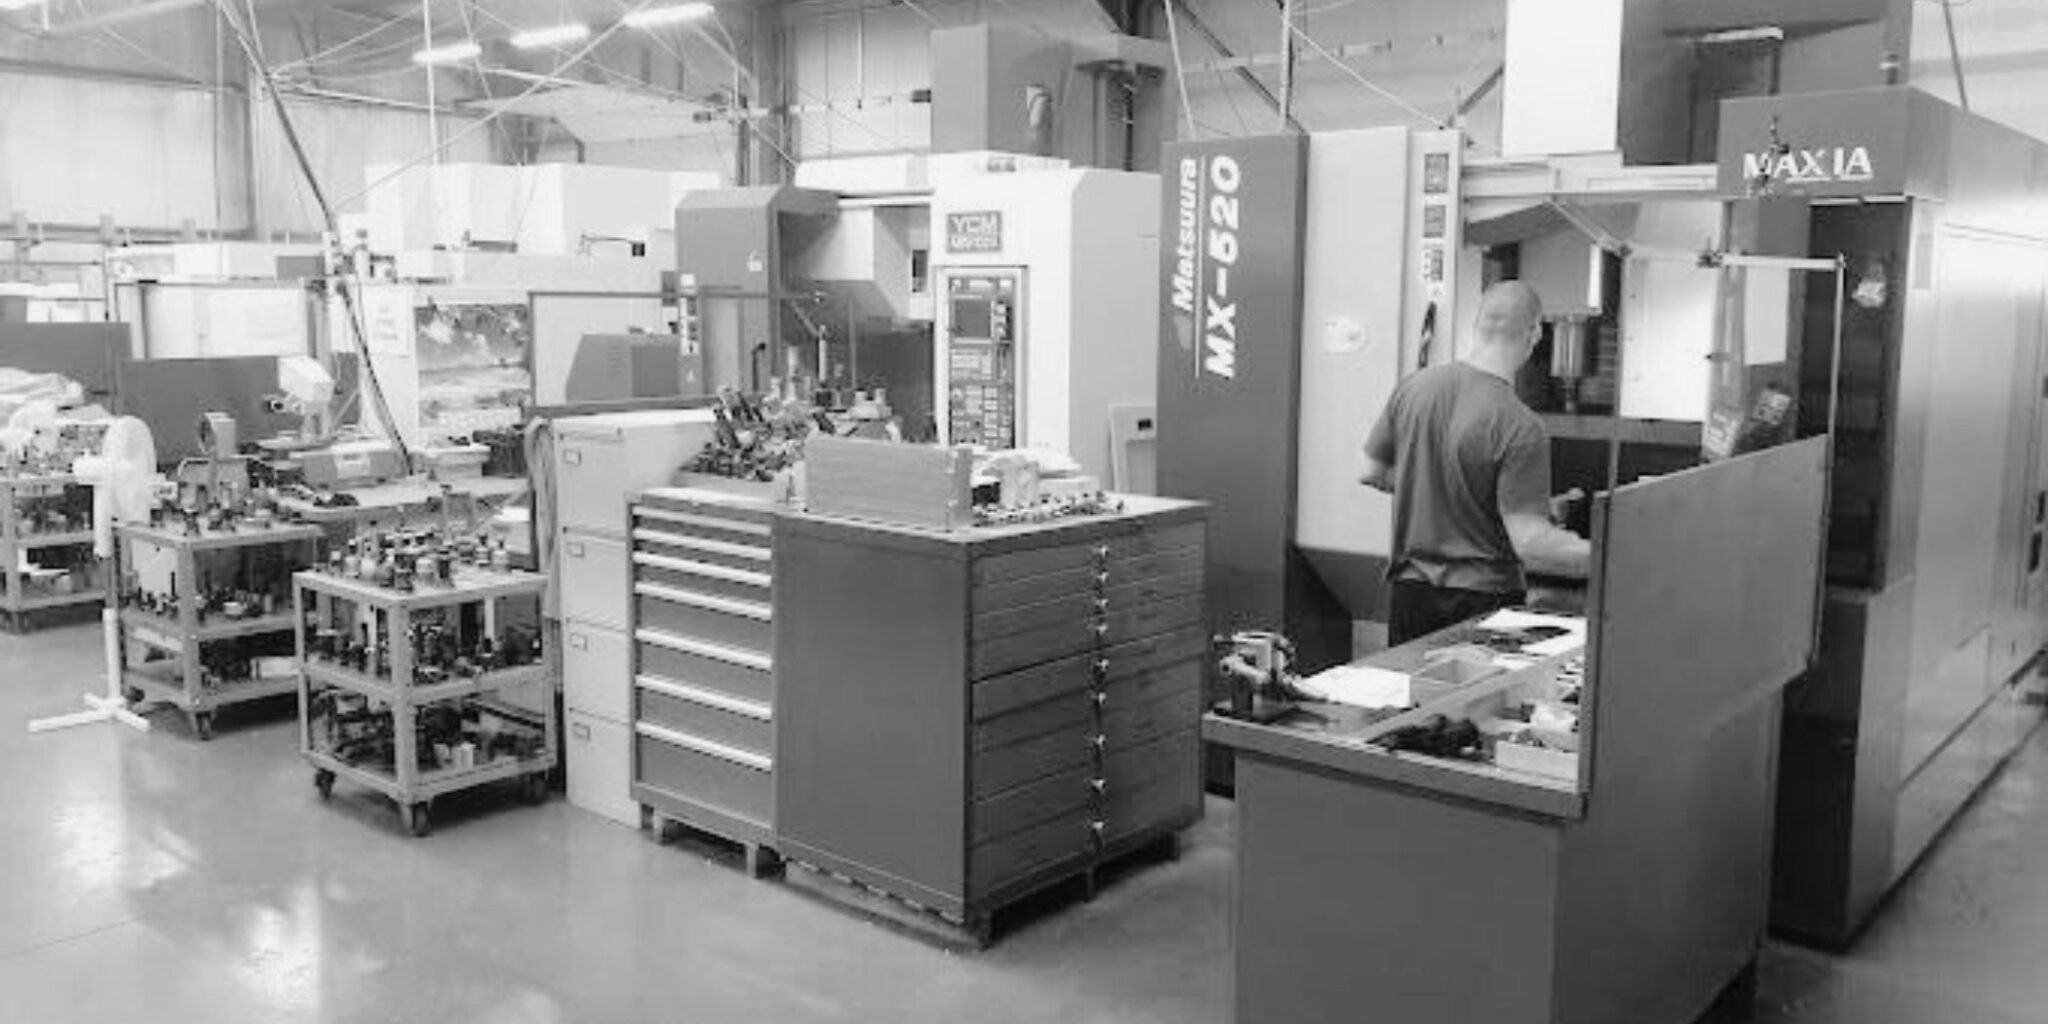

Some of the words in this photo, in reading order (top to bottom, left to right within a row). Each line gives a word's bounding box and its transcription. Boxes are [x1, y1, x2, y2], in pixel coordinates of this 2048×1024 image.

[948, 215, 997, 233] YCM
[1171, 158, 1196, 312] Matsuura
[1205, 155, 1240, 379] MX-520
